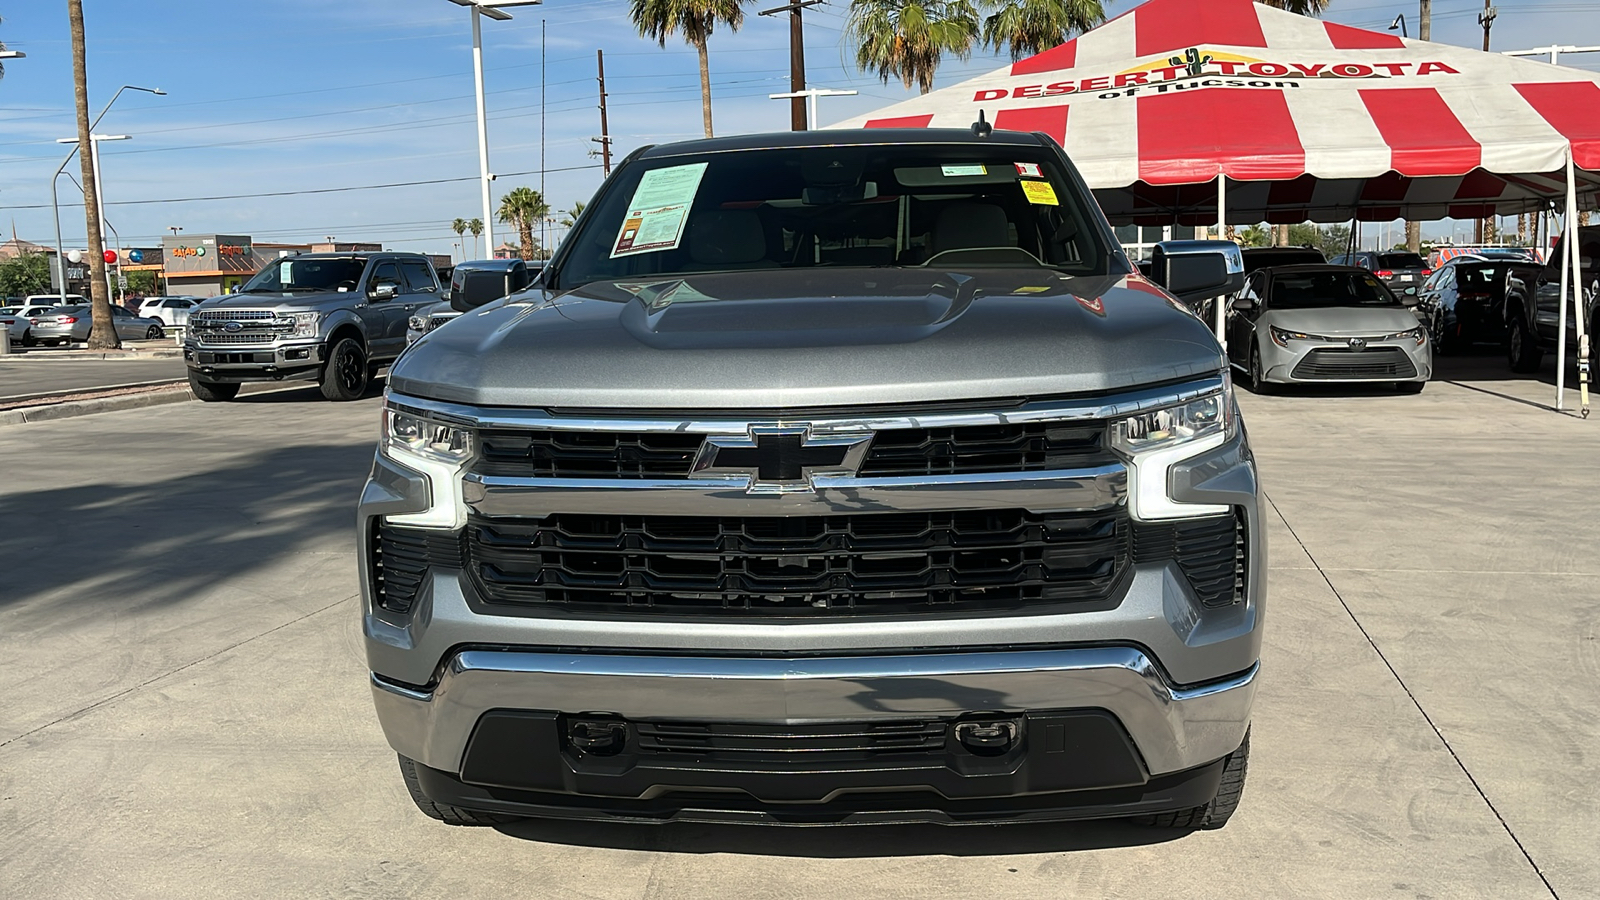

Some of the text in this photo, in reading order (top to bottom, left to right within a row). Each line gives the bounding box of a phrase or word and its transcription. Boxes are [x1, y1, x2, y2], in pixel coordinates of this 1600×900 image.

[973, 61, 1461, 102] DESERT TOYOTA
[1098, 79, 1300, 99] of Tucson
